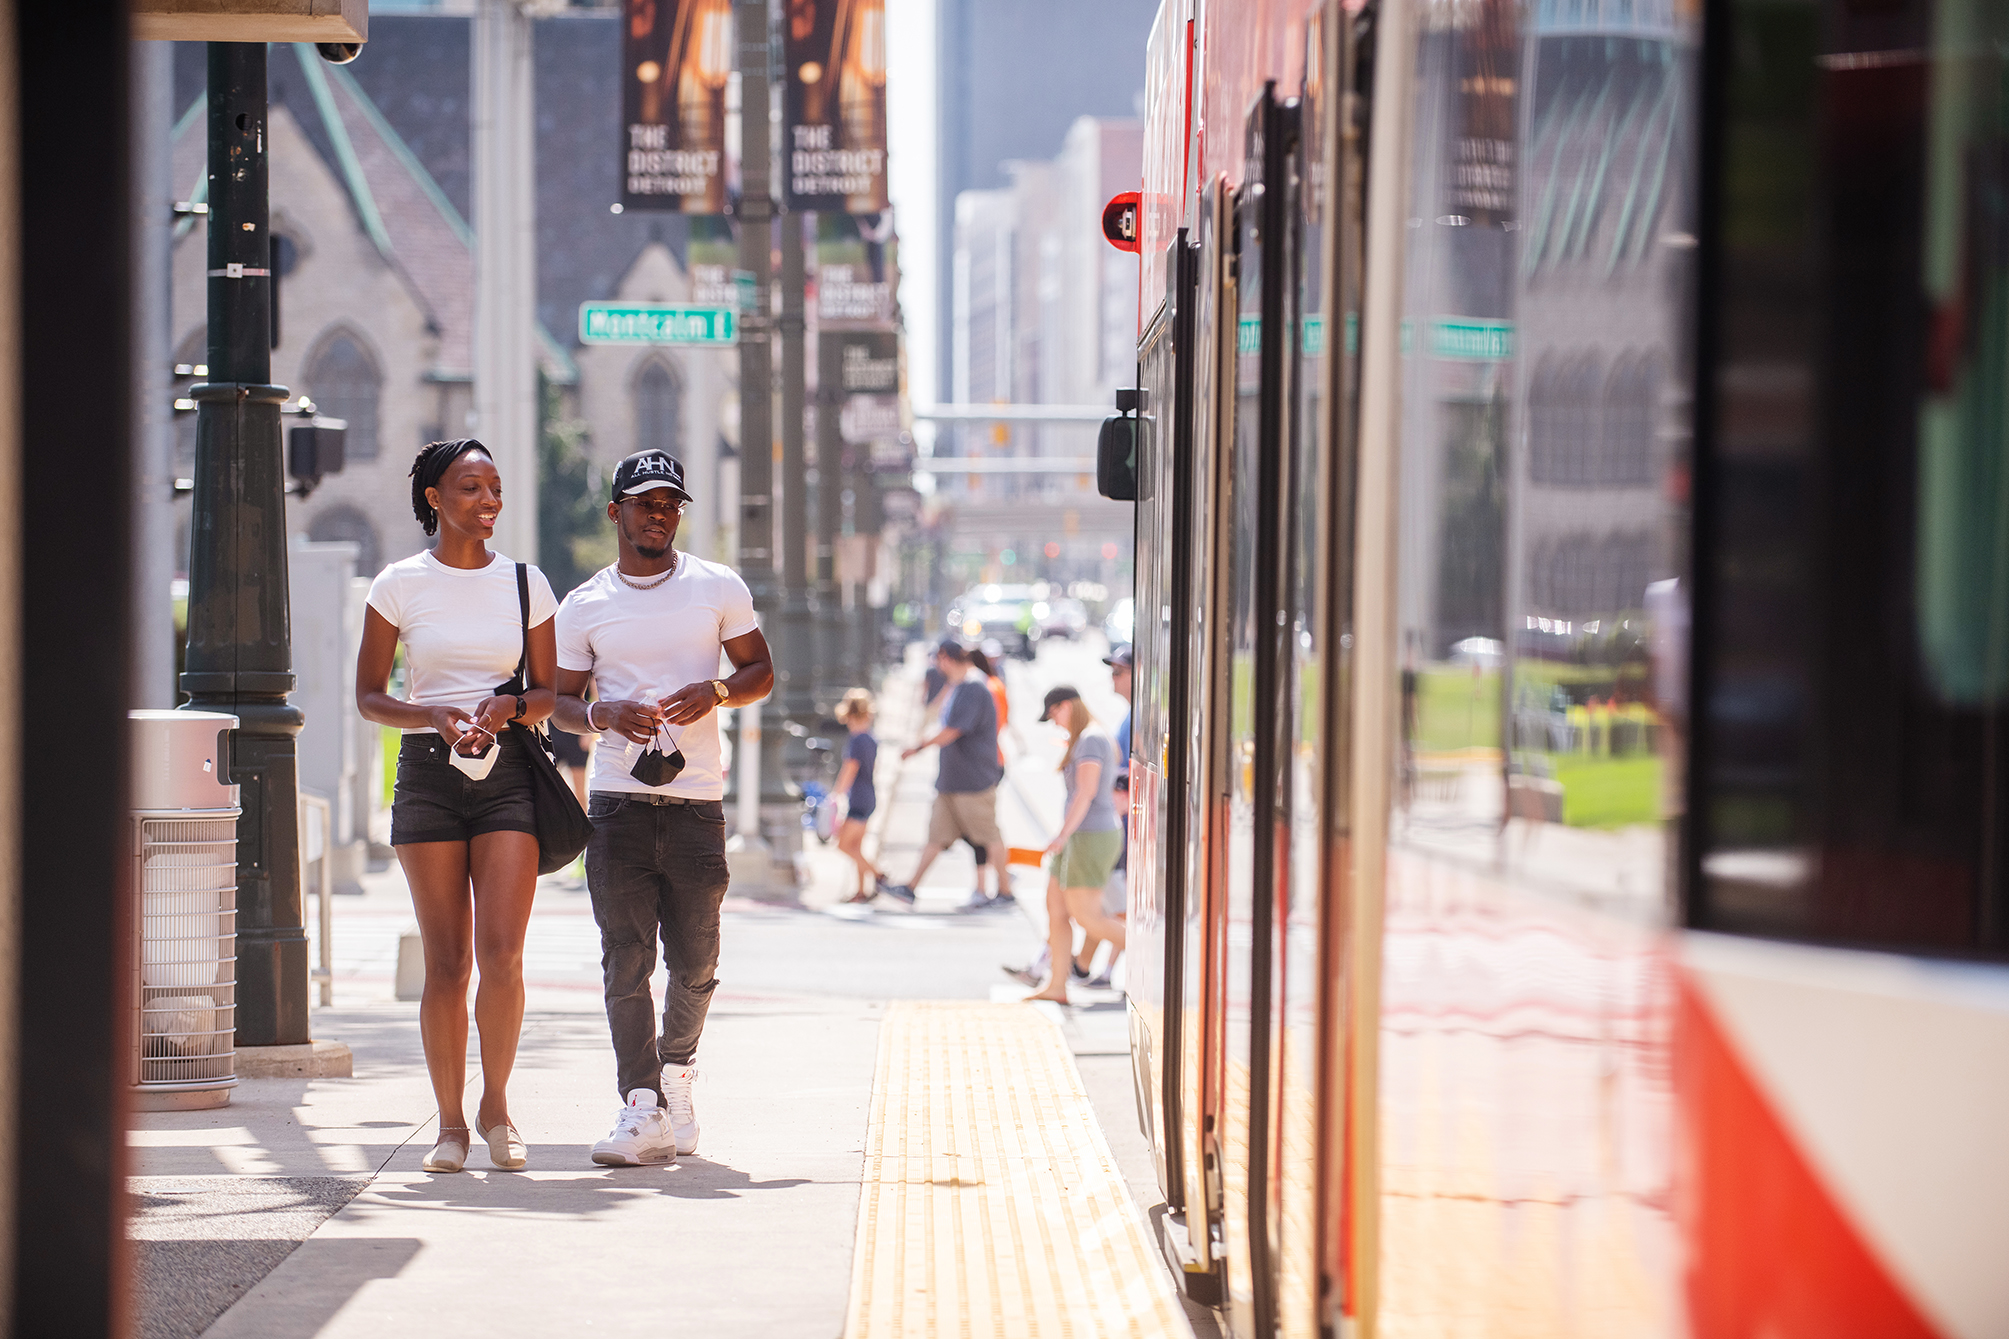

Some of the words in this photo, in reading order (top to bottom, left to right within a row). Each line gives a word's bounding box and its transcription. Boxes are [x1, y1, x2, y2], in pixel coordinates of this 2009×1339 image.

[628, 124, 669, 149] THE
[792, 124, 833, 149] THE
[627, 149, 720, 175] DISTRICT
[792, 149, 885, 175] DISTRICT
[627, 175, 707, 195] DETROIT
[792, 175, 871, 195] DETROIT
[588, 309, 709, 340] Montcalm
[633, 456, 681, 479] AHN
